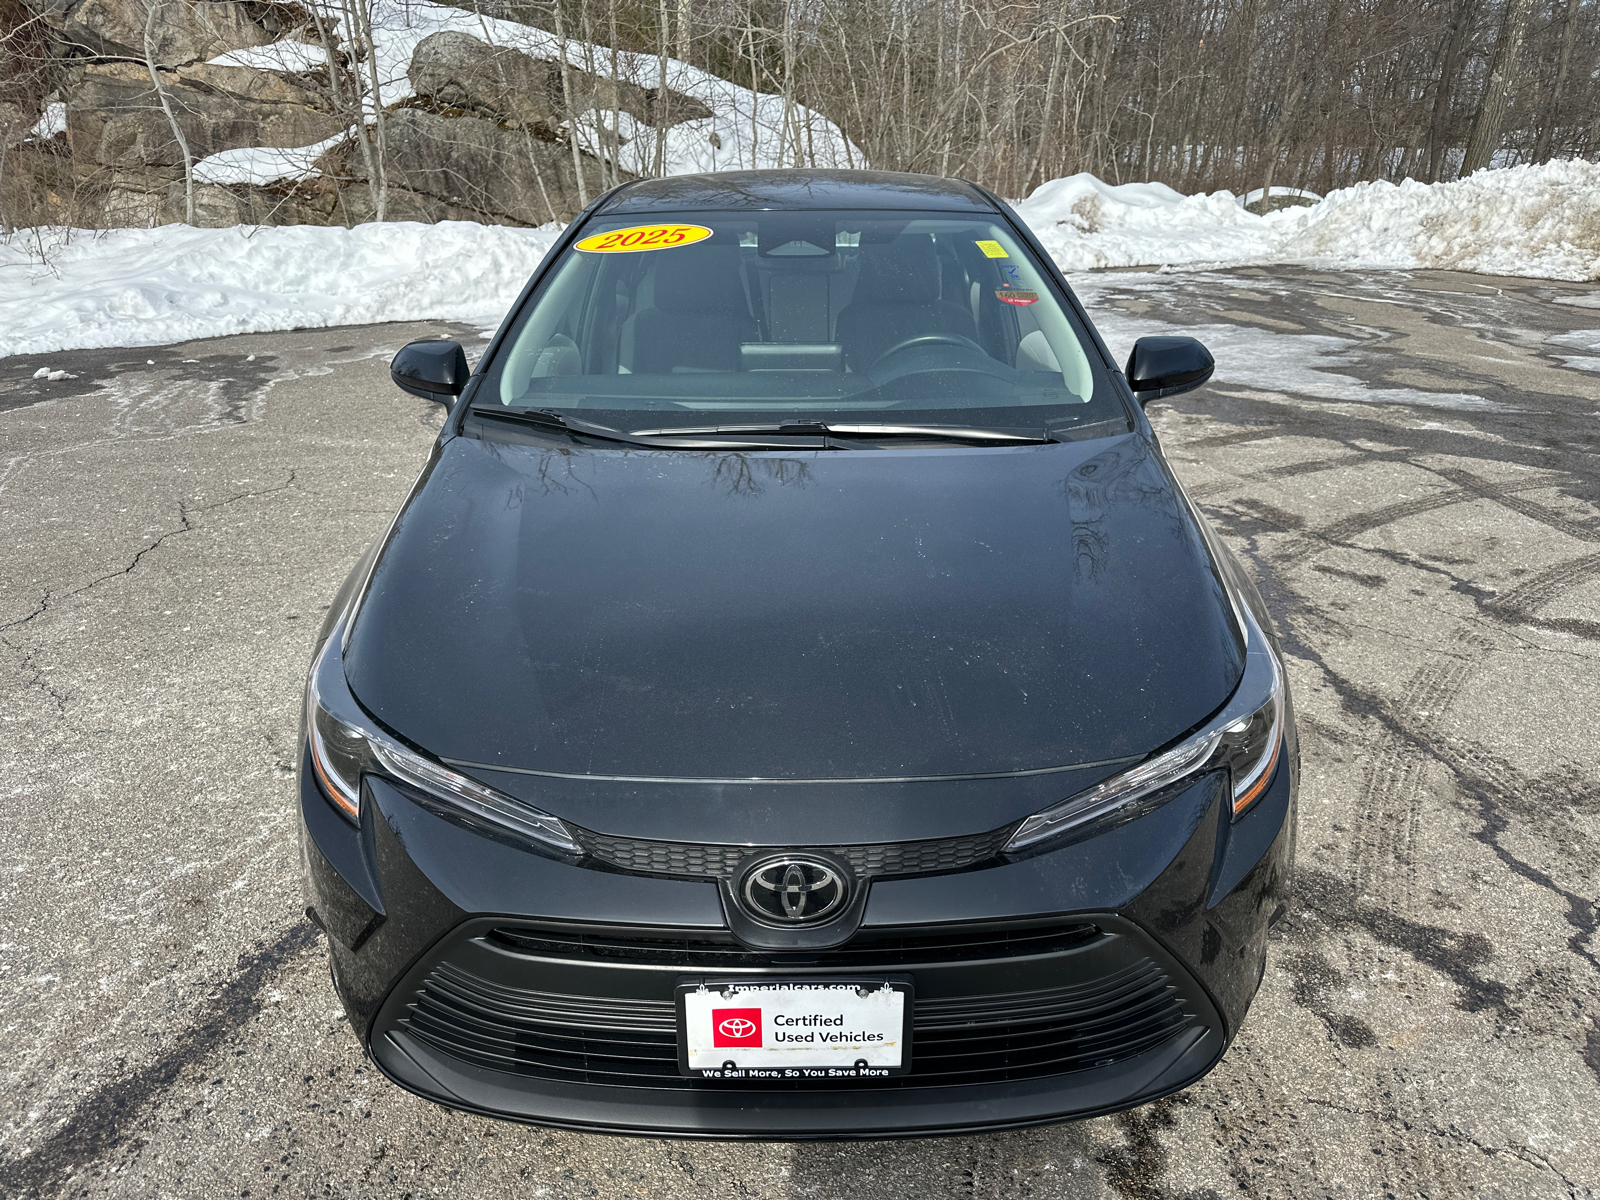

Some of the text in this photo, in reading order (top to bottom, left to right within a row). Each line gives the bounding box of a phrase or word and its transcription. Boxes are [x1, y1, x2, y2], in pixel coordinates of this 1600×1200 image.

[595, 228, 692, 249] 2025
[728, 983, 861, 992] Imperialcars.com
[774, 1014, 844, 1027] Certified
[775, 1031, 884, 1043] Used Vehicles
[724, 1069, 745, 1077] Sell
[749, 1069, 782, 1078] More,
[785, 1069, 800, 1077] So
[803, 1069, 824, 1077] You
[860, 1068, 889, 1076] More
